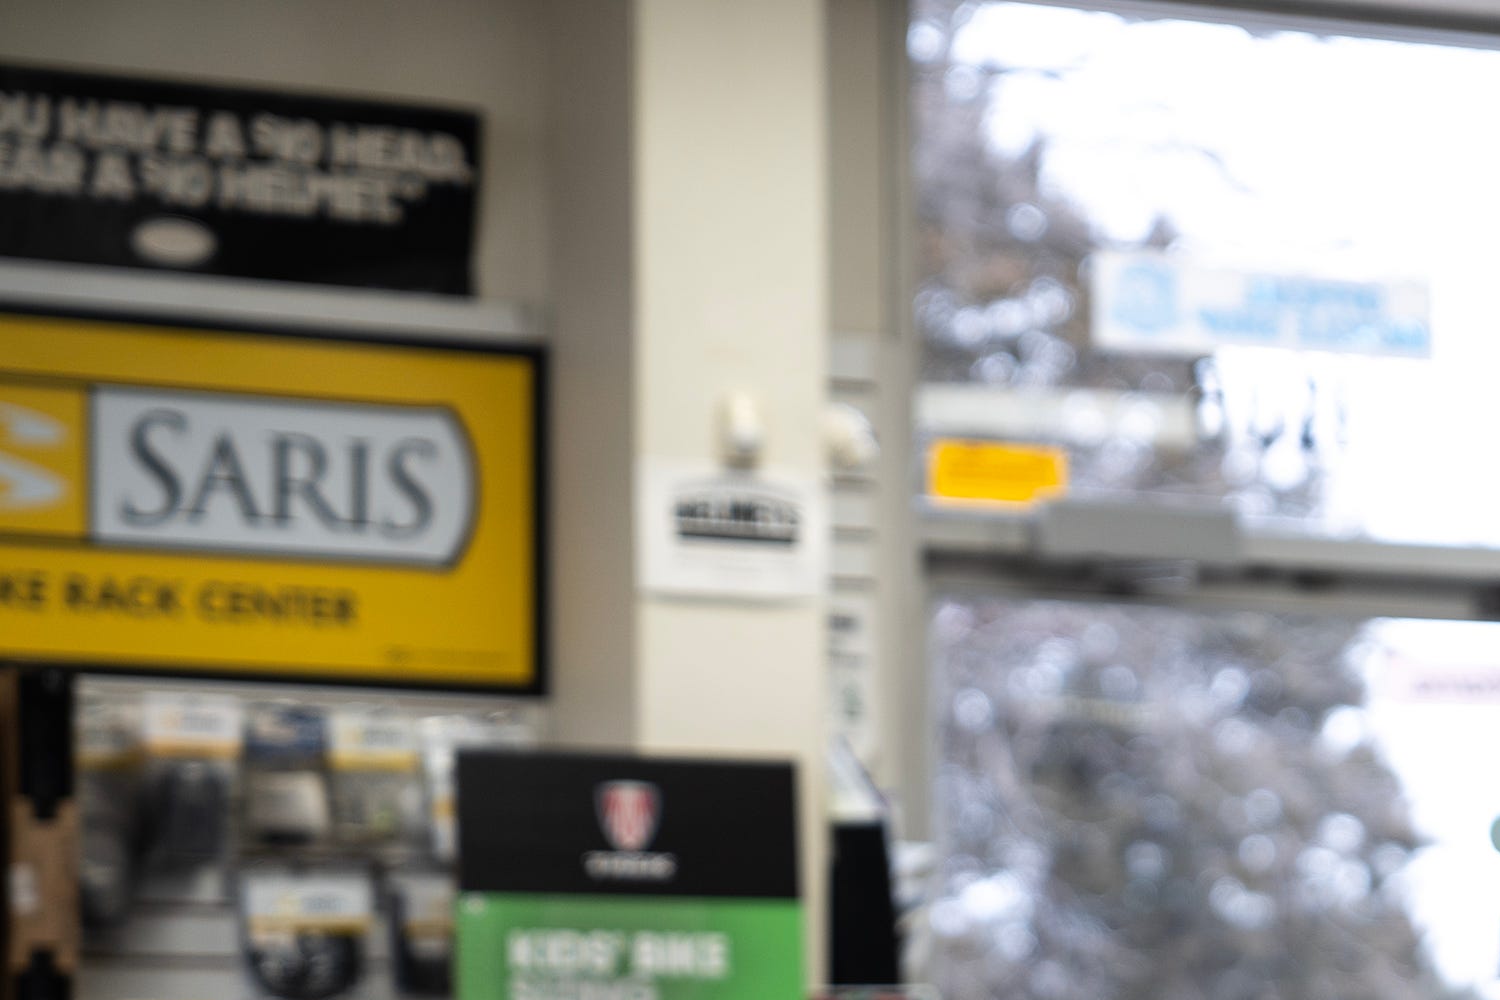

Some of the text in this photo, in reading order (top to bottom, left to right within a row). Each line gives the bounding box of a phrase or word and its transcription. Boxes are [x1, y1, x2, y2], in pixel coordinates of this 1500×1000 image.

[58, 95, 200, 154] HAVE
[205, 109, 249, 158] A
[94, 147, 138, 201] A
[117, 406, 442, 542] SARIS
[62, 572, 188, 620] RACK
[197, 579, 360, 630] CENTER
